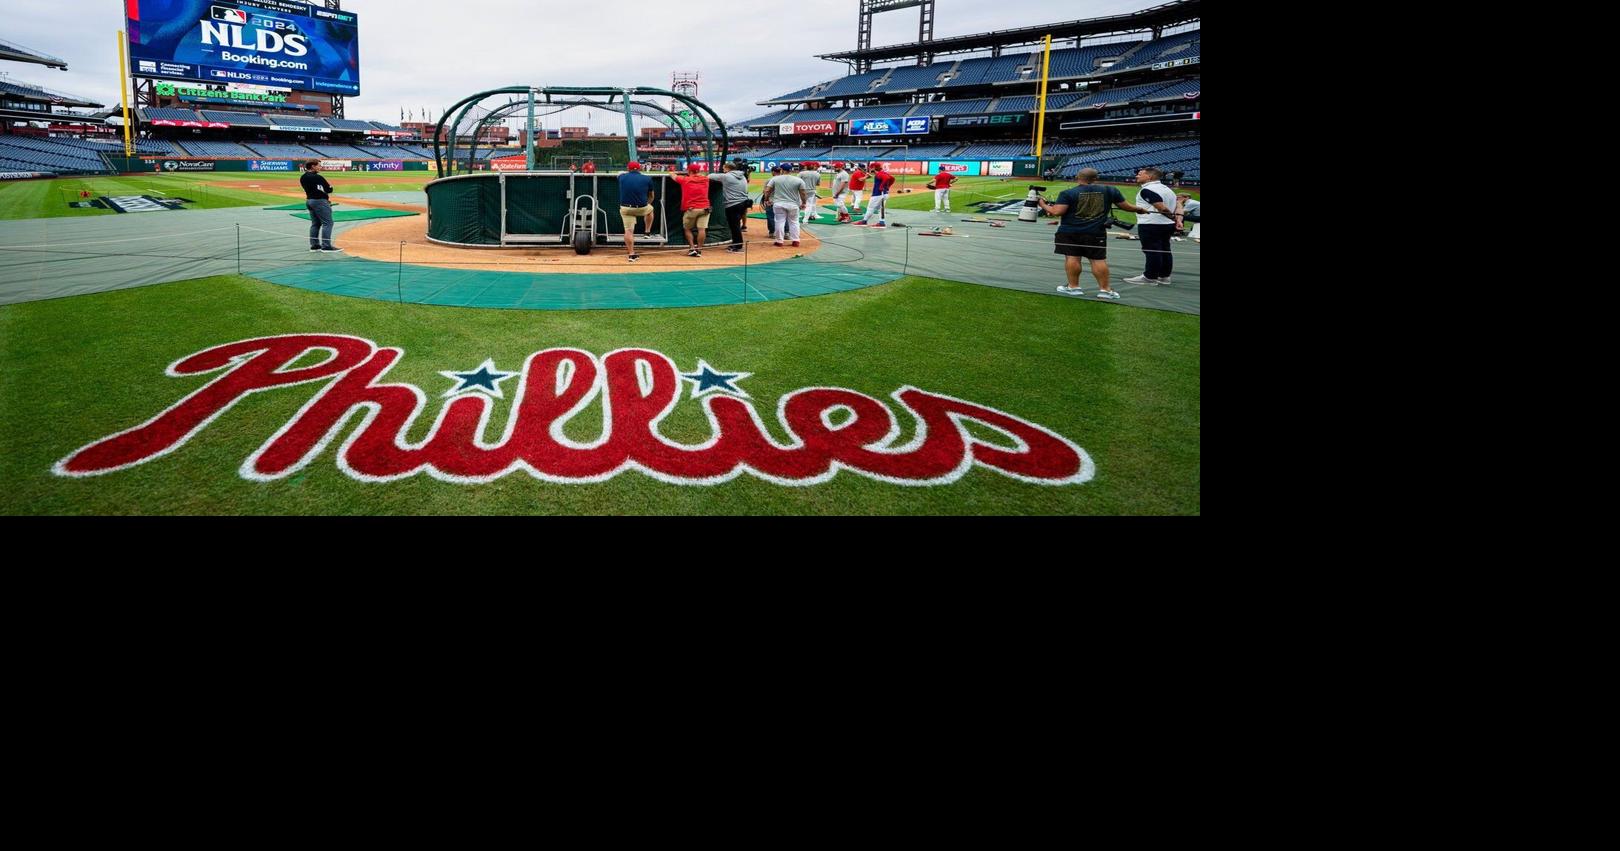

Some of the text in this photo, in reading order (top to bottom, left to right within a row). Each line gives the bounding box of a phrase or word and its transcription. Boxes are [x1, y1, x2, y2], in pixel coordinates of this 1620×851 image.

[264, 5, 292, 13] LAWYERS
[252, 18, 296, 32] 2024
[200, 19, 308, 57] NLDS
[222, 51, 308, 70] Booking.com
[227, 71, 251, 80] NLDS
[271, 77, 304, 86] Booking.com
[177, 86, 229, 99] Citizens
[230, 90, 261, 101] Bank
[261, 93, 287, 103] Park
[796, 123, 833, 132] TOYOTA
[372, 162, 400, 170] xfinity
[50, 333, 1095, 487] Phillies
